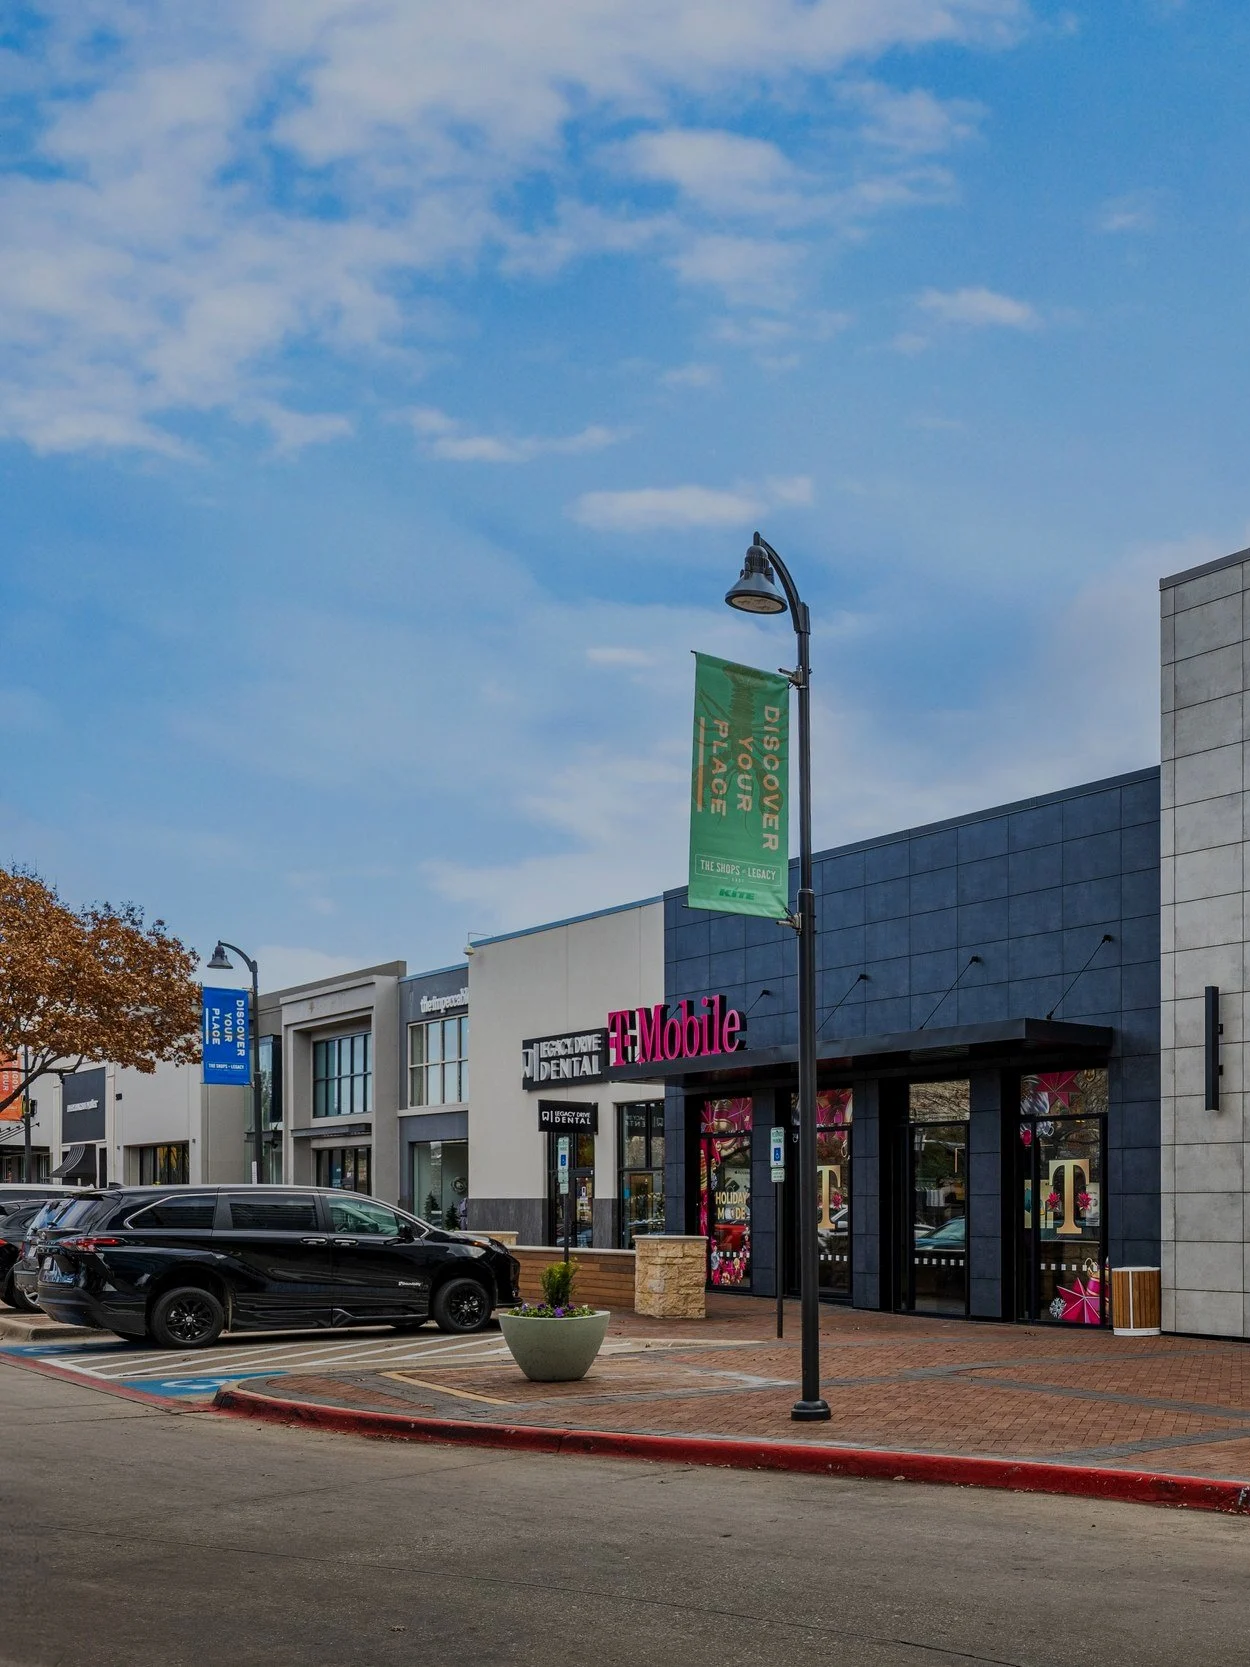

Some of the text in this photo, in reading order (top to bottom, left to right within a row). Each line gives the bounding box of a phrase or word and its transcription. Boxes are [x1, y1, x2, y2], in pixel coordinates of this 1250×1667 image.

[711, 718, 729, 816] PLACE
[737, 736, 754, 813] YOUR
[763, 705, 780, 852] DISCOVER
[700, 859, 715, 872] THE
[716, 863, 741, 876] SHOPS
[747, 867, 777, 881] LEGACY
[211, 1007, 221, 1046] PLACE
[224, 1012, 233, 1043] YOUR
[236, 999, 246, 1057] DISCOVER
[540, 1033, 602, 1059] LEGACY DRIVE
[540, 1054, 602, 1081] DENTAL
[554, 1110, 576, 1118] LEGACY
[554, 1116, 591, 1125] DENTAL
[715, 1191, 748, 1205] HOLIDAY
[817, 1165, 842, 1229] T
[1048, 1159, 1090, 1234] T
